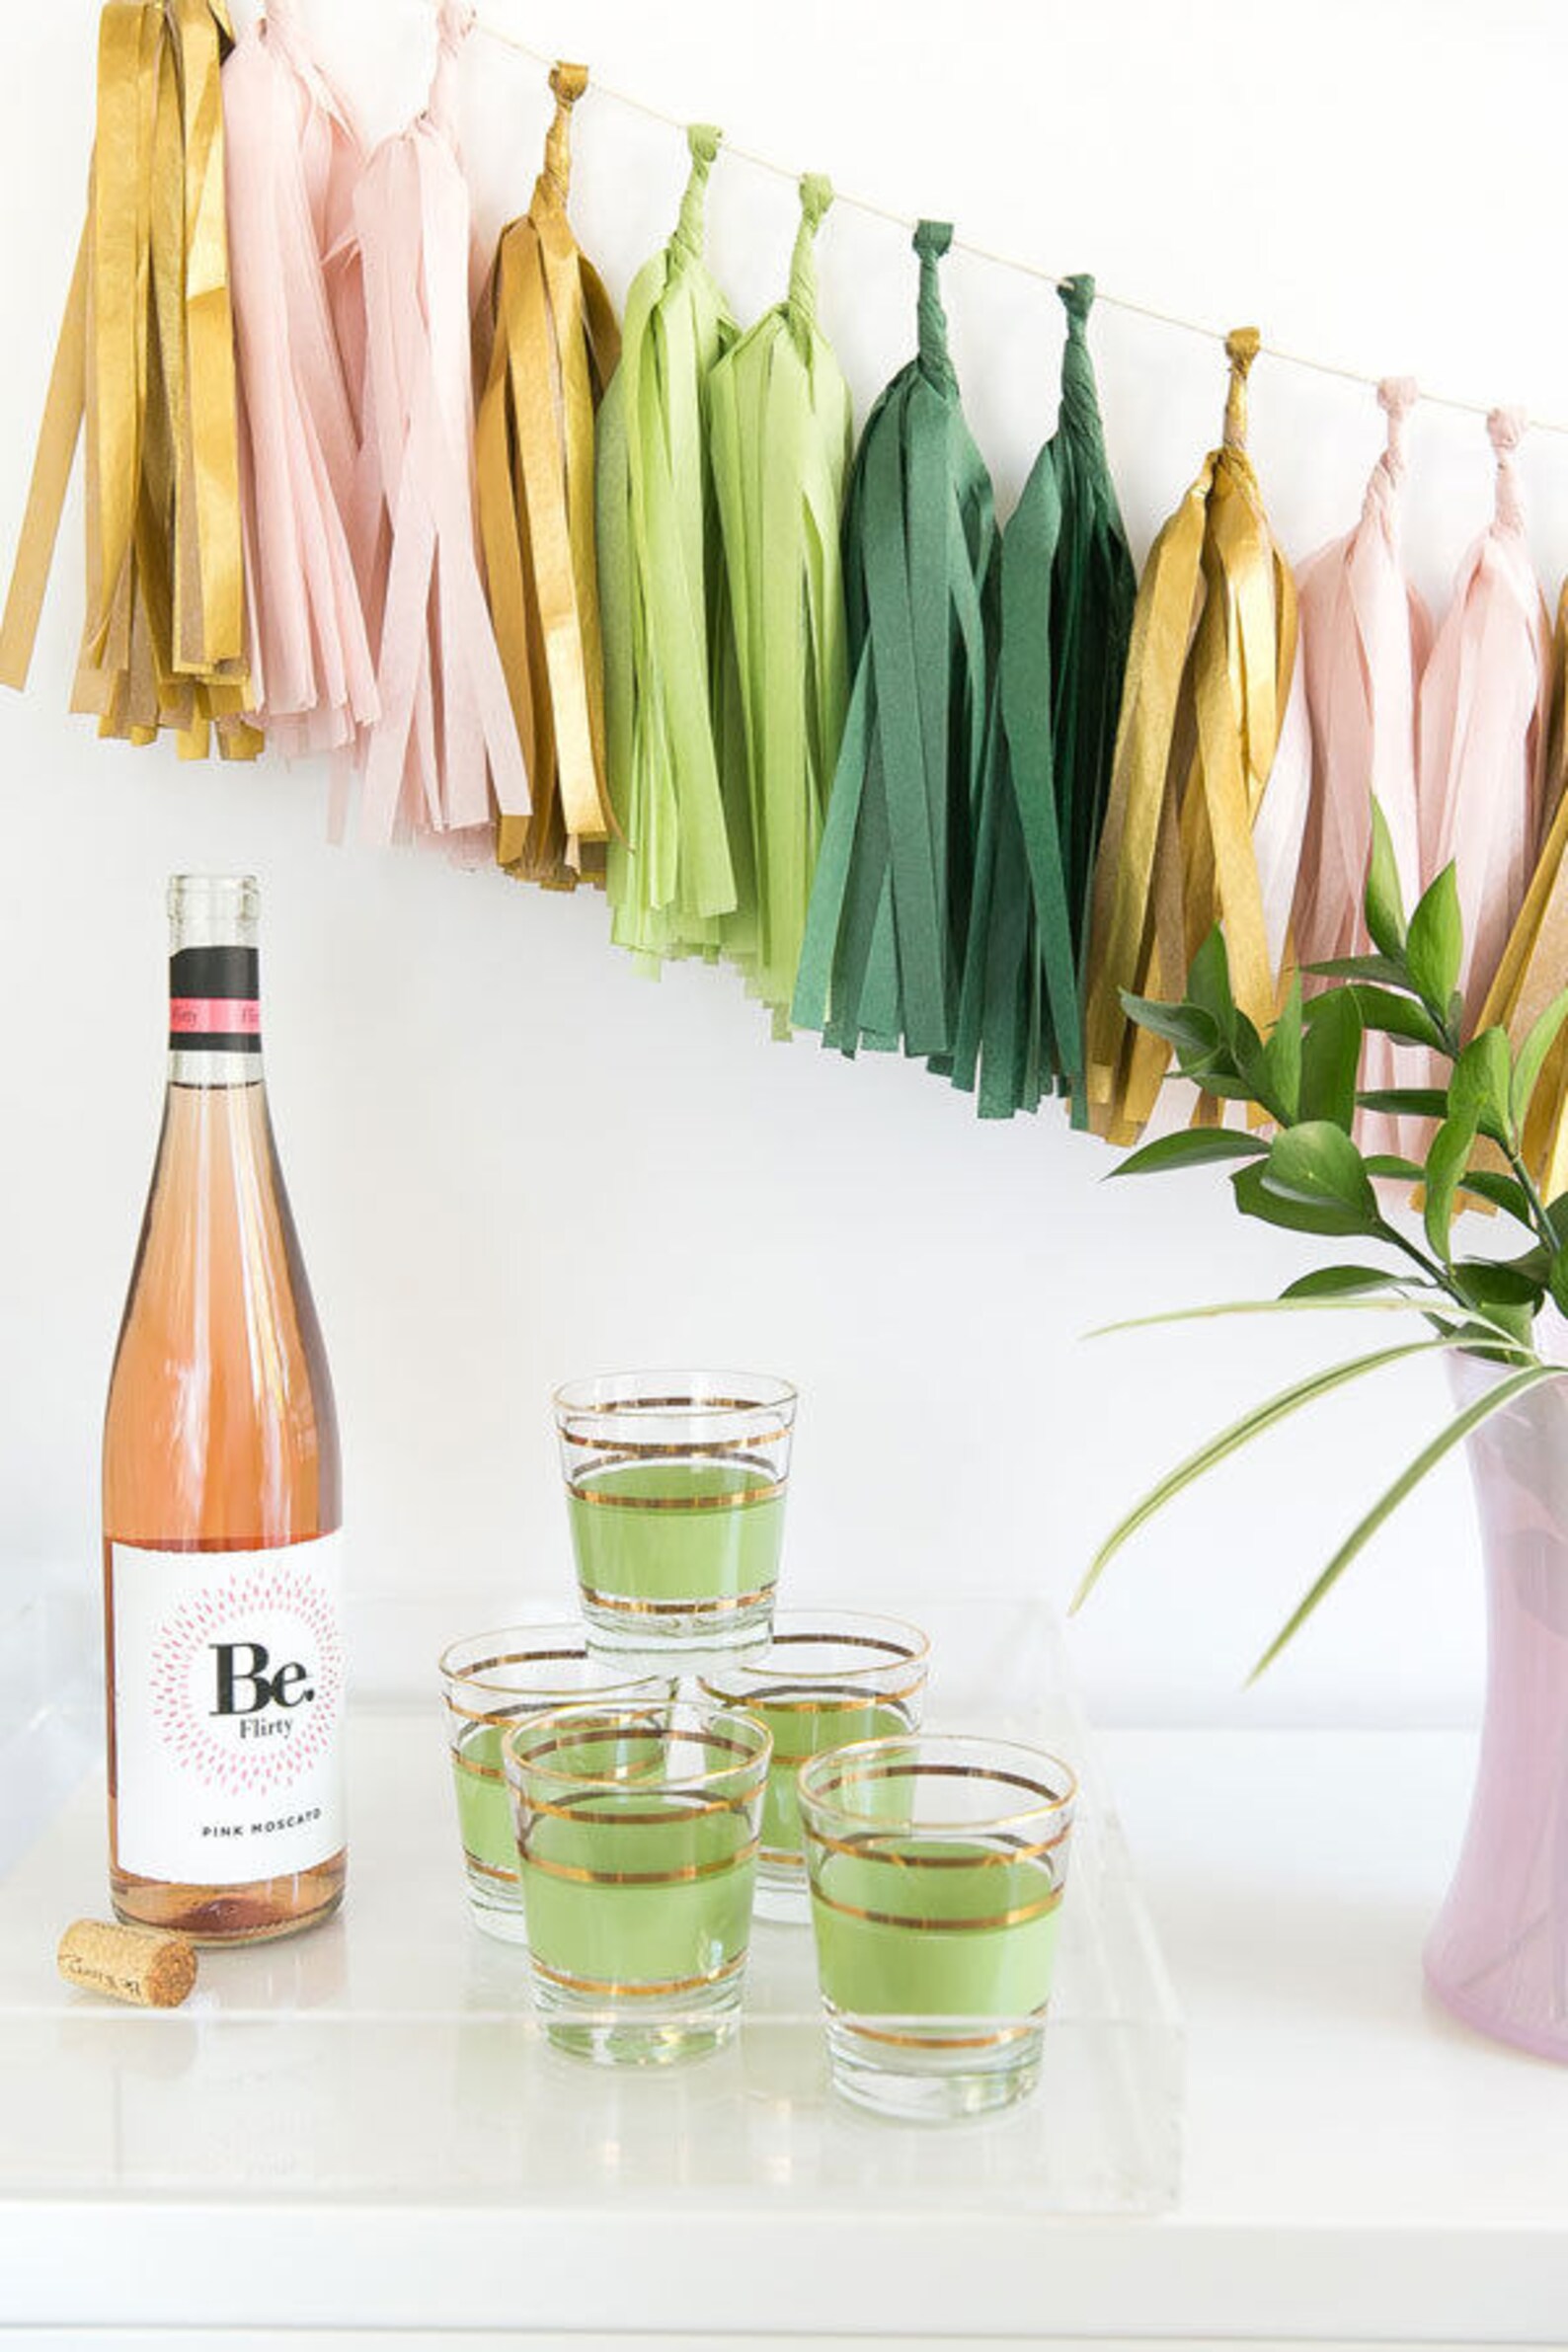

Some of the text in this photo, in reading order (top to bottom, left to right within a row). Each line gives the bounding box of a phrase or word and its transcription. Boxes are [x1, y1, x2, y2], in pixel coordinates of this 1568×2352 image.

[208, 1641, 315, 1716] Be.
[239, 1717, 293, 1740] Flirty
[201, 1807, 322, 1839] PINK MOSCATO
